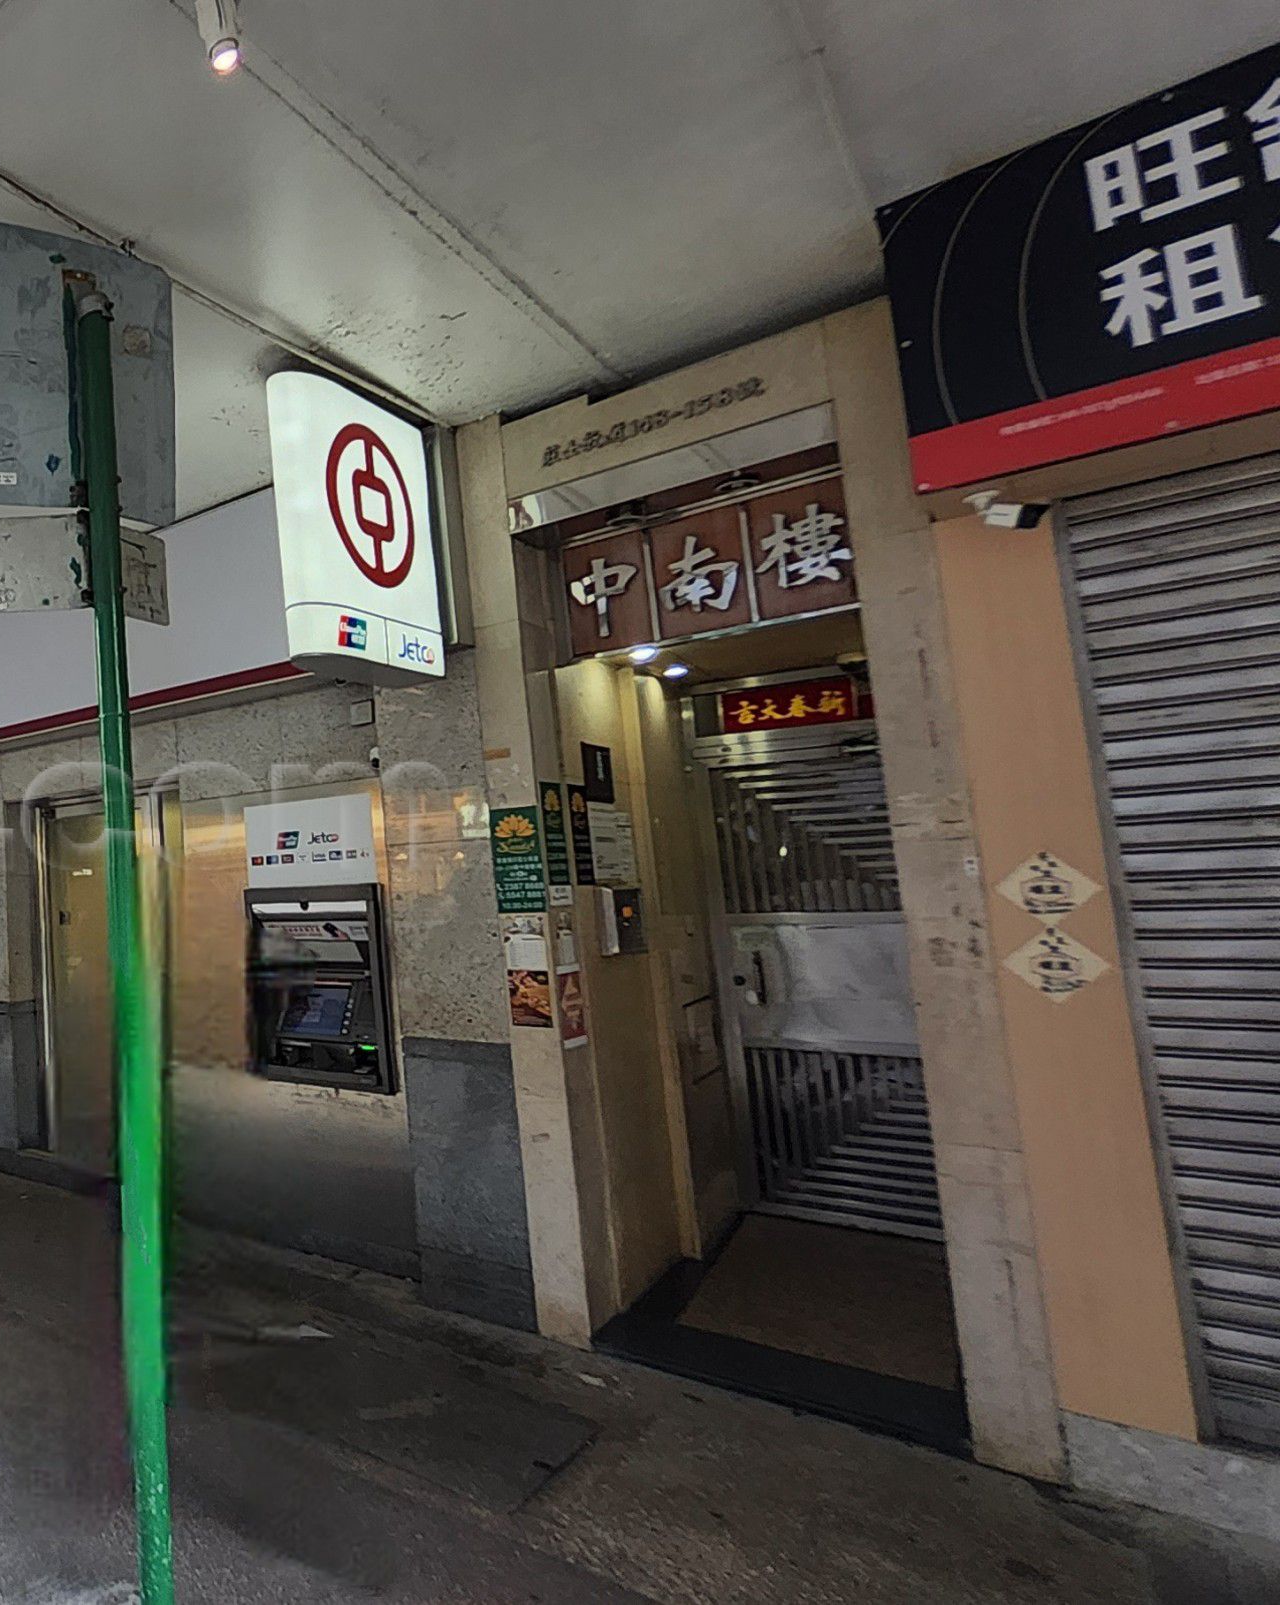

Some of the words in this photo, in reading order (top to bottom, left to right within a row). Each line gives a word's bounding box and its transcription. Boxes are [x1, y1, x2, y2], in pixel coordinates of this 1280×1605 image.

[1084, 77, 1280, 232] 旺
[571, 503, 854, 637] 中南樓
[398, 633, 435, 665] Jetco
[307, 831, 339, 845] Jetco
